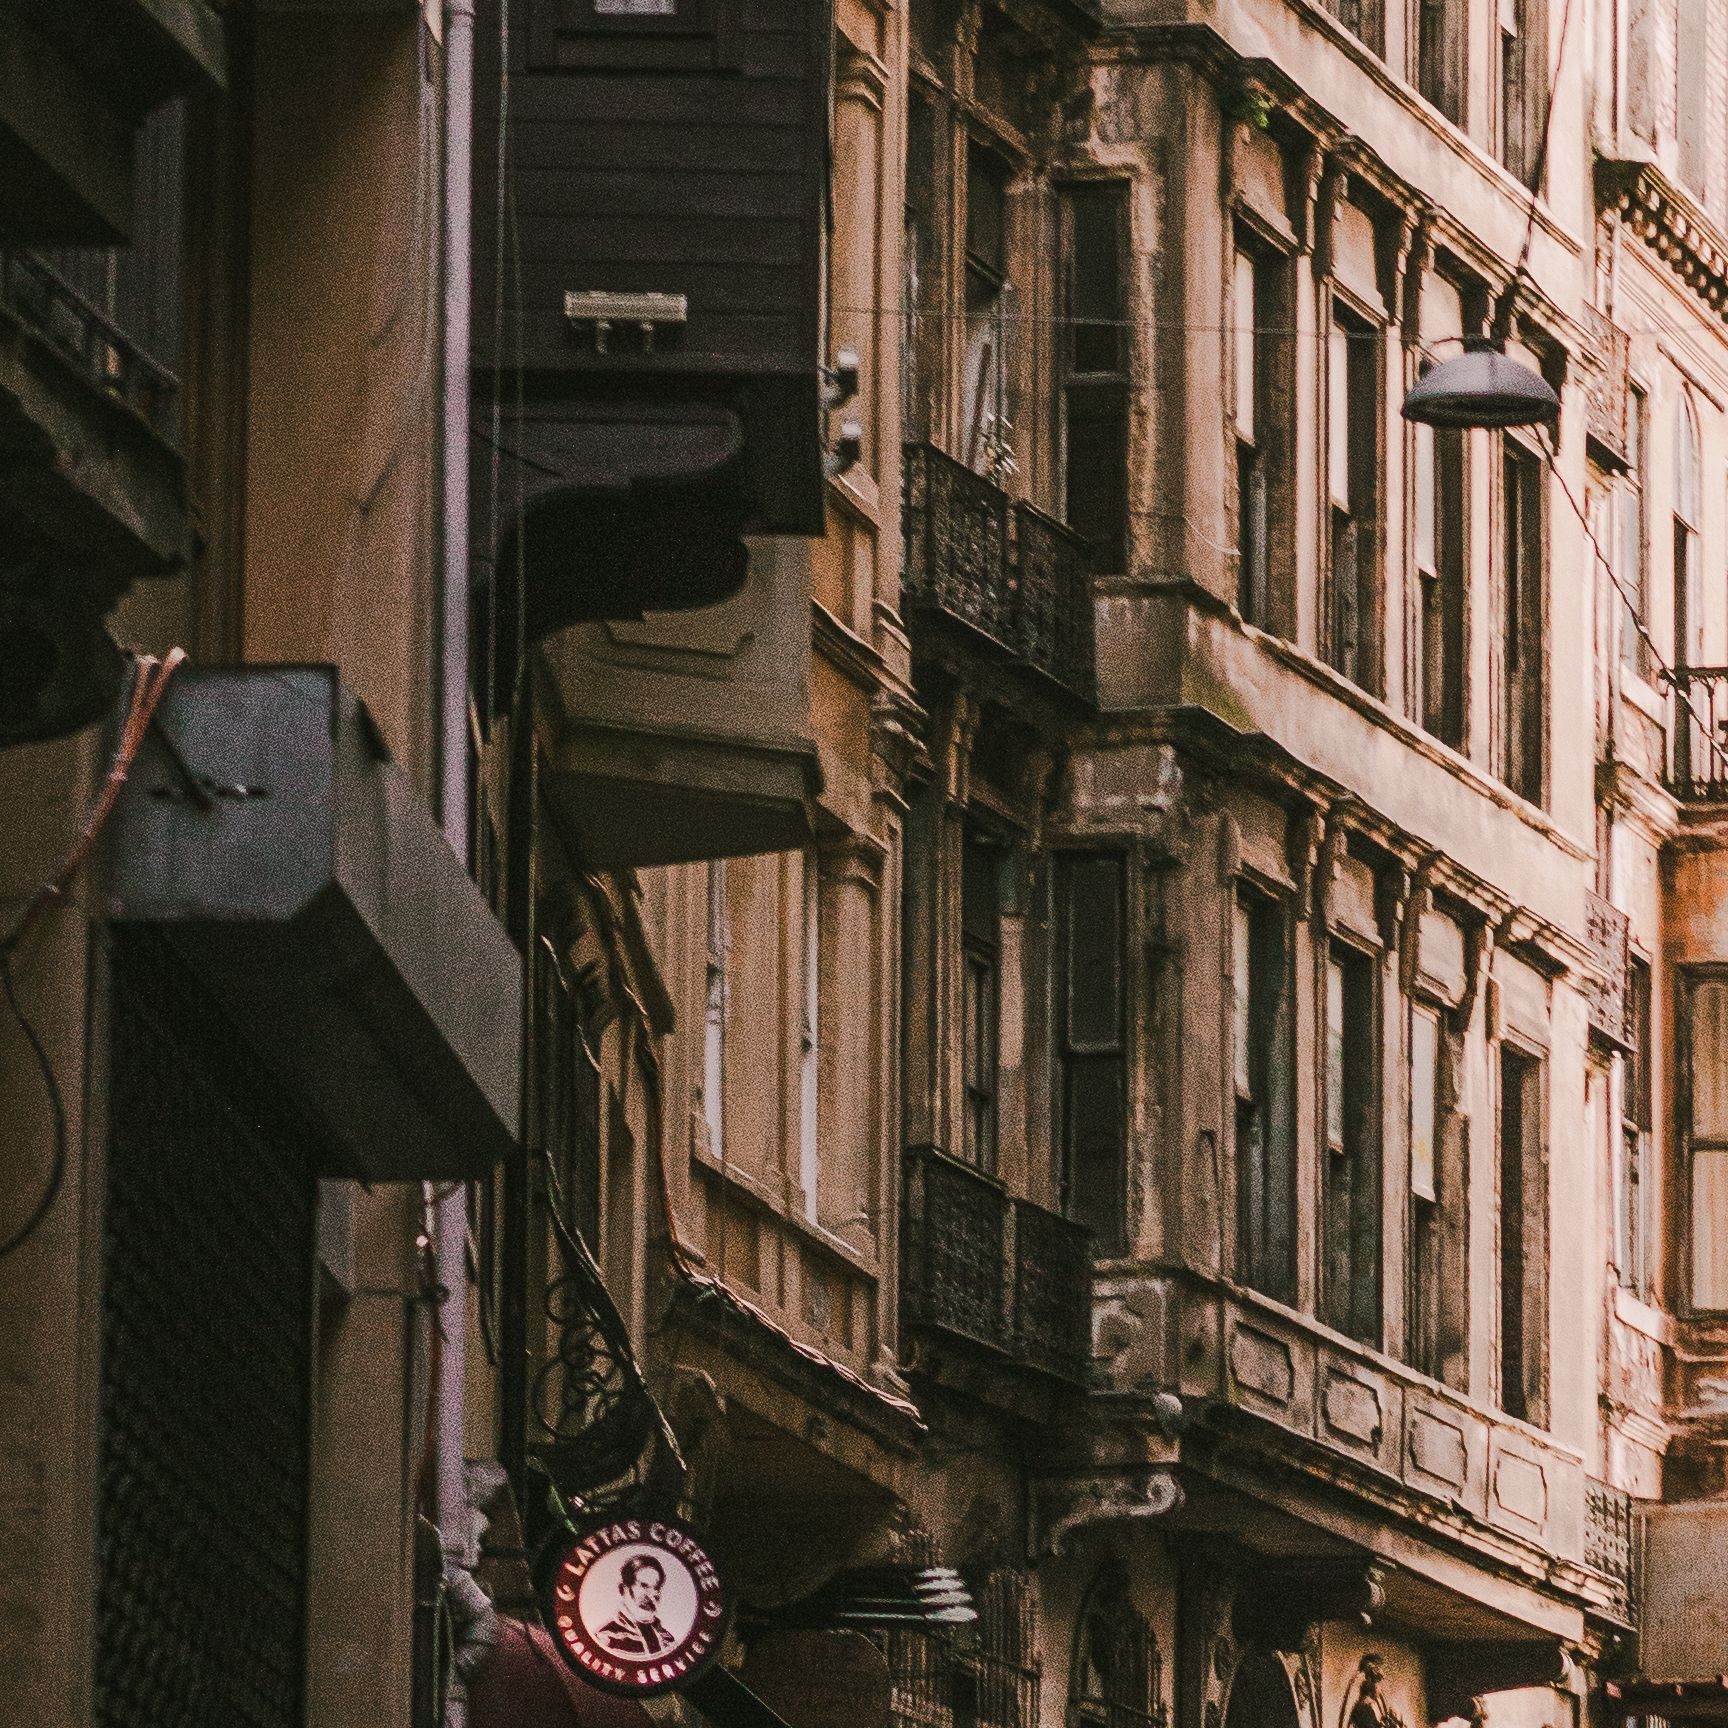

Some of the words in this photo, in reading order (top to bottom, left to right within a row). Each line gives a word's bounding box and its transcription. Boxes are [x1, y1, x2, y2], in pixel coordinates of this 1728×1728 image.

[566, 1519, 641, 1577] LATTAS
[648, 1522, 721, 1593] COFFEE
[556, 1615, 626, 1682] QUALITY
[636, 1630, 714, 1684] SERVICE
